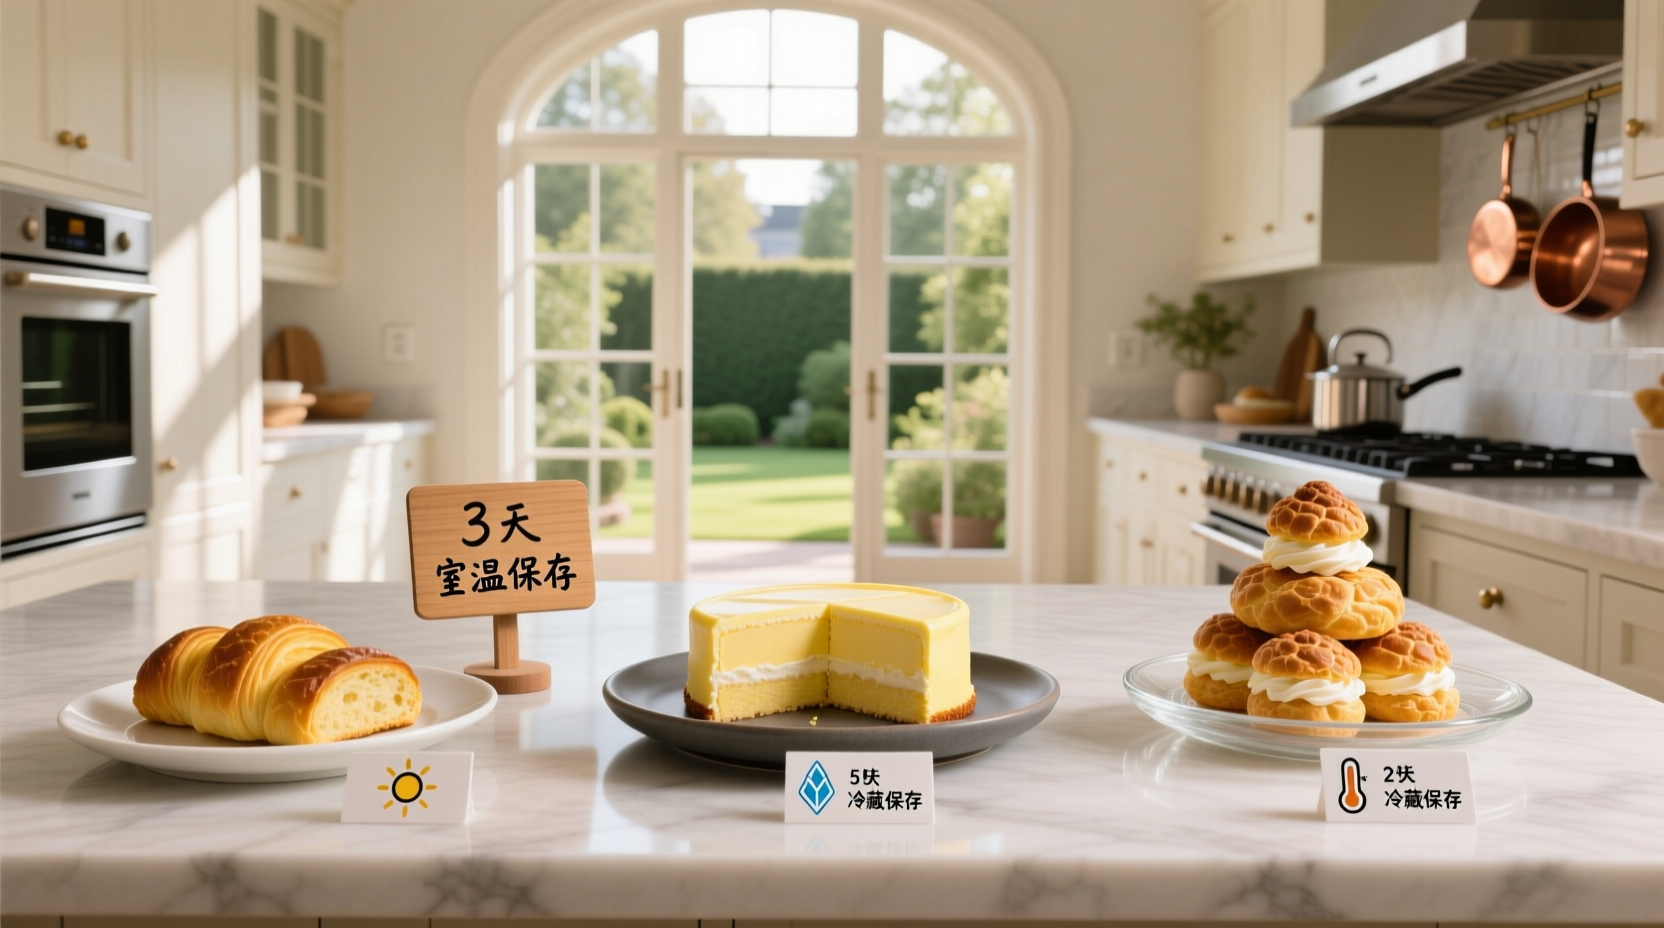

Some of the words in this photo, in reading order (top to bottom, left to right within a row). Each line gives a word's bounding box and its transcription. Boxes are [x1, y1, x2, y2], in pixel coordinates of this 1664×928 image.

[461, 501, 542, 548] 3天
[436, 552, 577, 598] 室温保存
